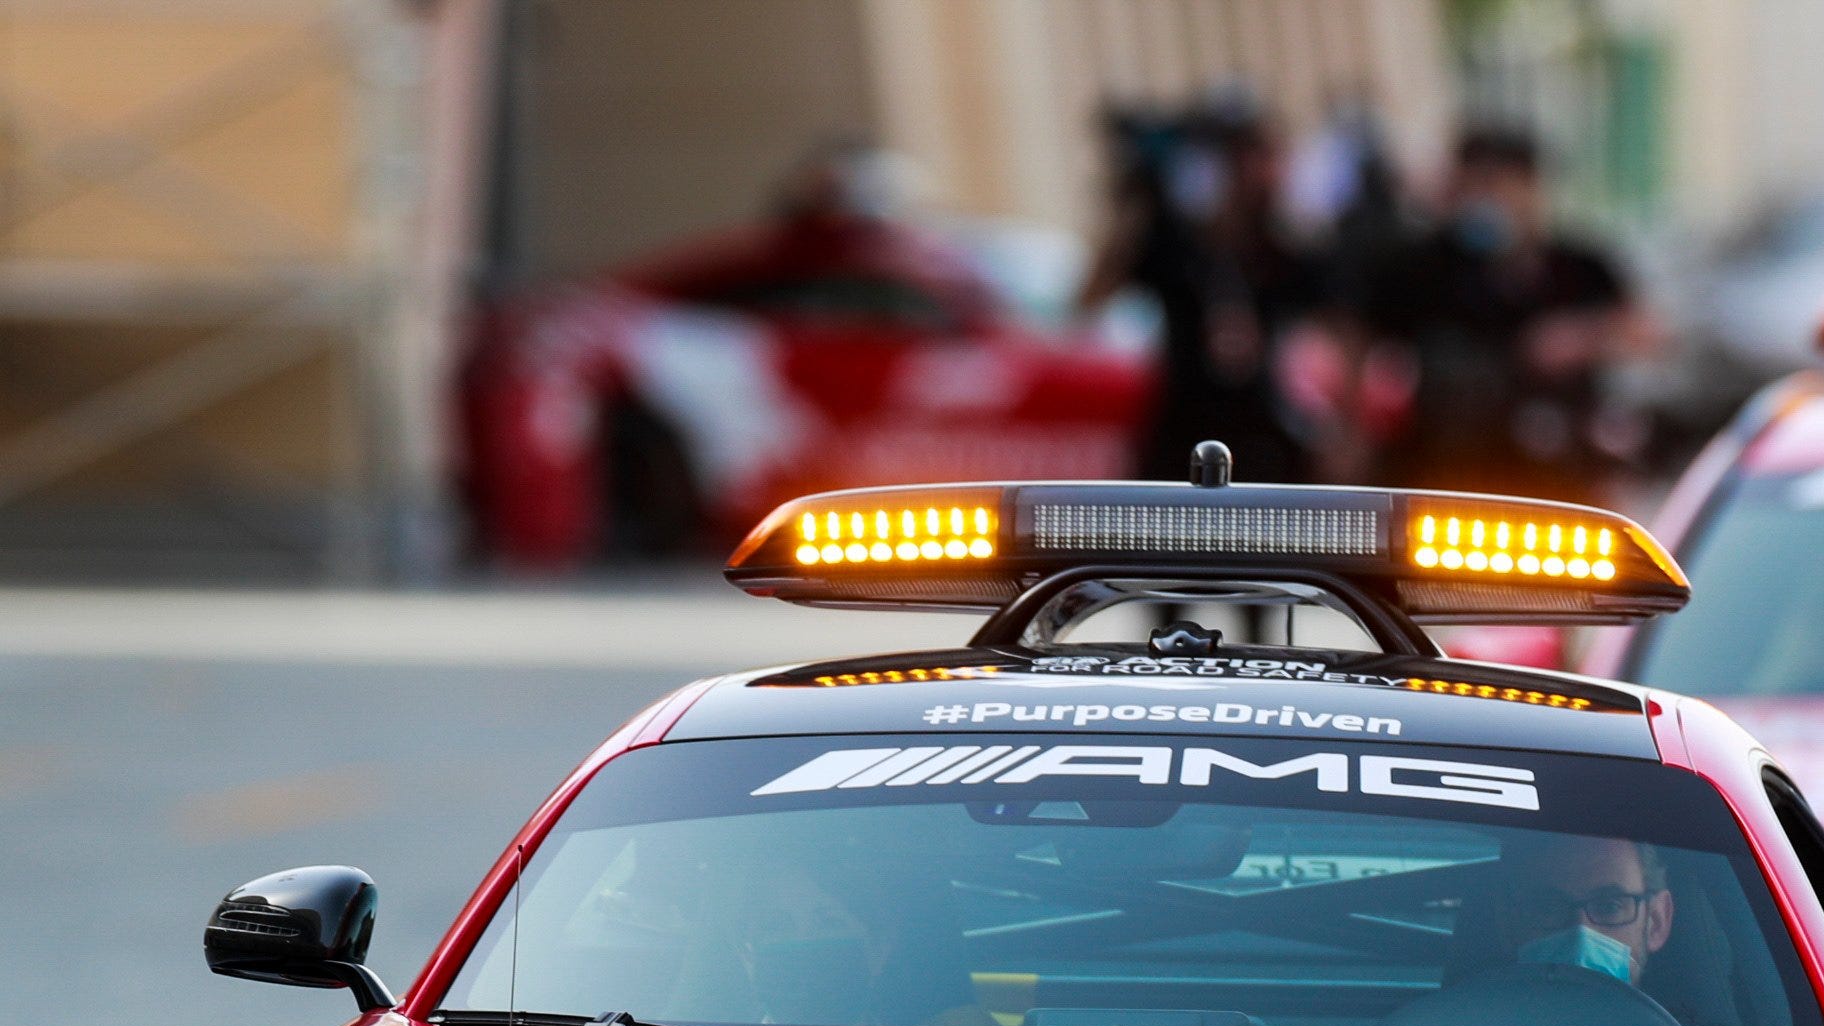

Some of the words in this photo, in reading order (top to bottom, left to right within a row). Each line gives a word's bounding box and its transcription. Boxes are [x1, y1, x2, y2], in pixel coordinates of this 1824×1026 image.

[1030, 665, 1092, 673] FOR
[1101, 665, 1224, 675] ROAD
[1236, 666, 1408, 686] SAFETY
[1117, 656, 1326, 672] ACTION
[922, 702, 1402, 735] #PurposeDriven
[995, 746, 1541, 811] AMG
